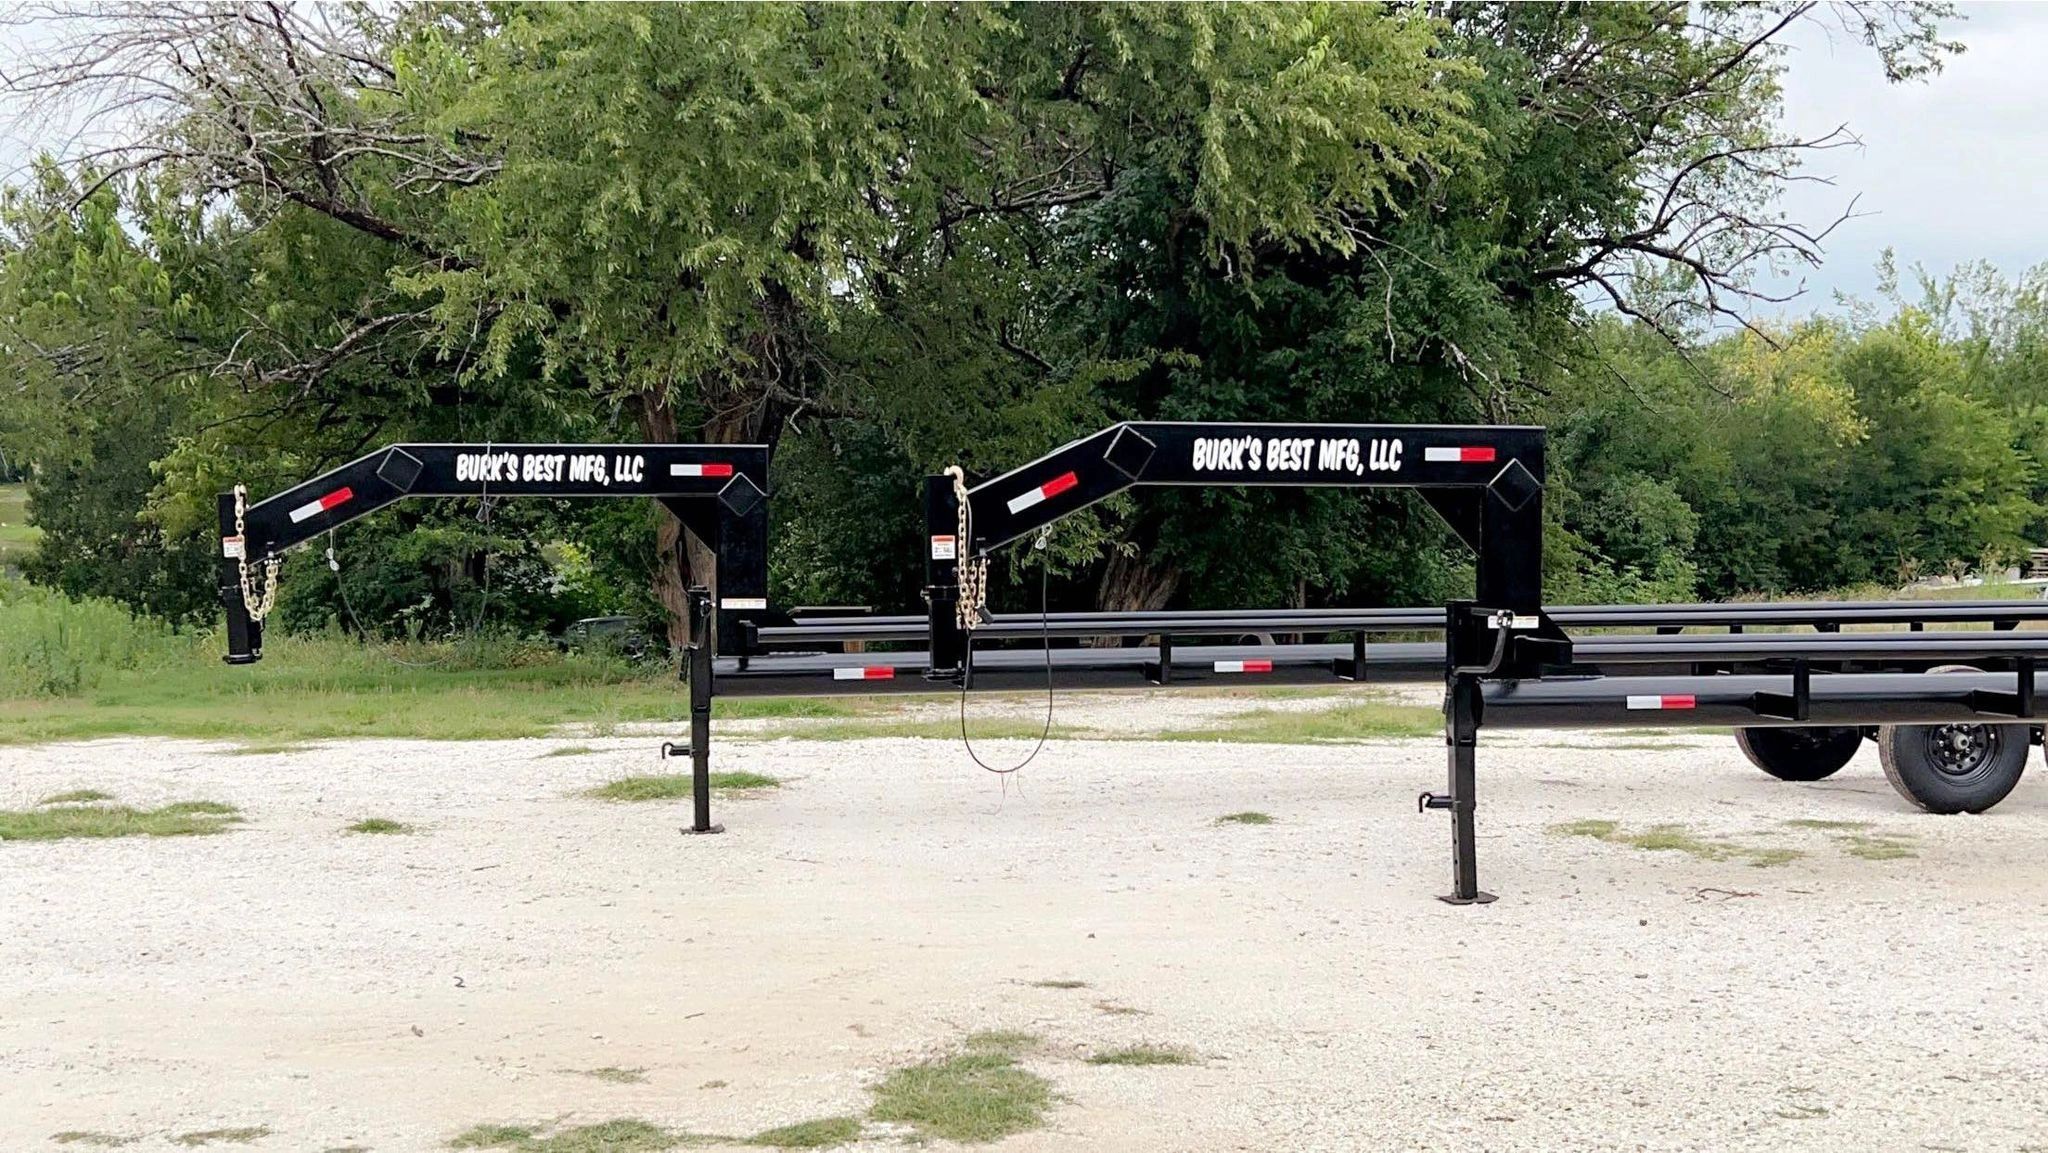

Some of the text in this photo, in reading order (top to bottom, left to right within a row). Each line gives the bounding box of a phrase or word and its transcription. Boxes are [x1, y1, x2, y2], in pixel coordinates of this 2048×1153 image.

[456, 451, 644, 486] BURK'S BEST MFG, LLC
[1193, 435, 1403, 476] BURK'S BEST MFG, LLC
